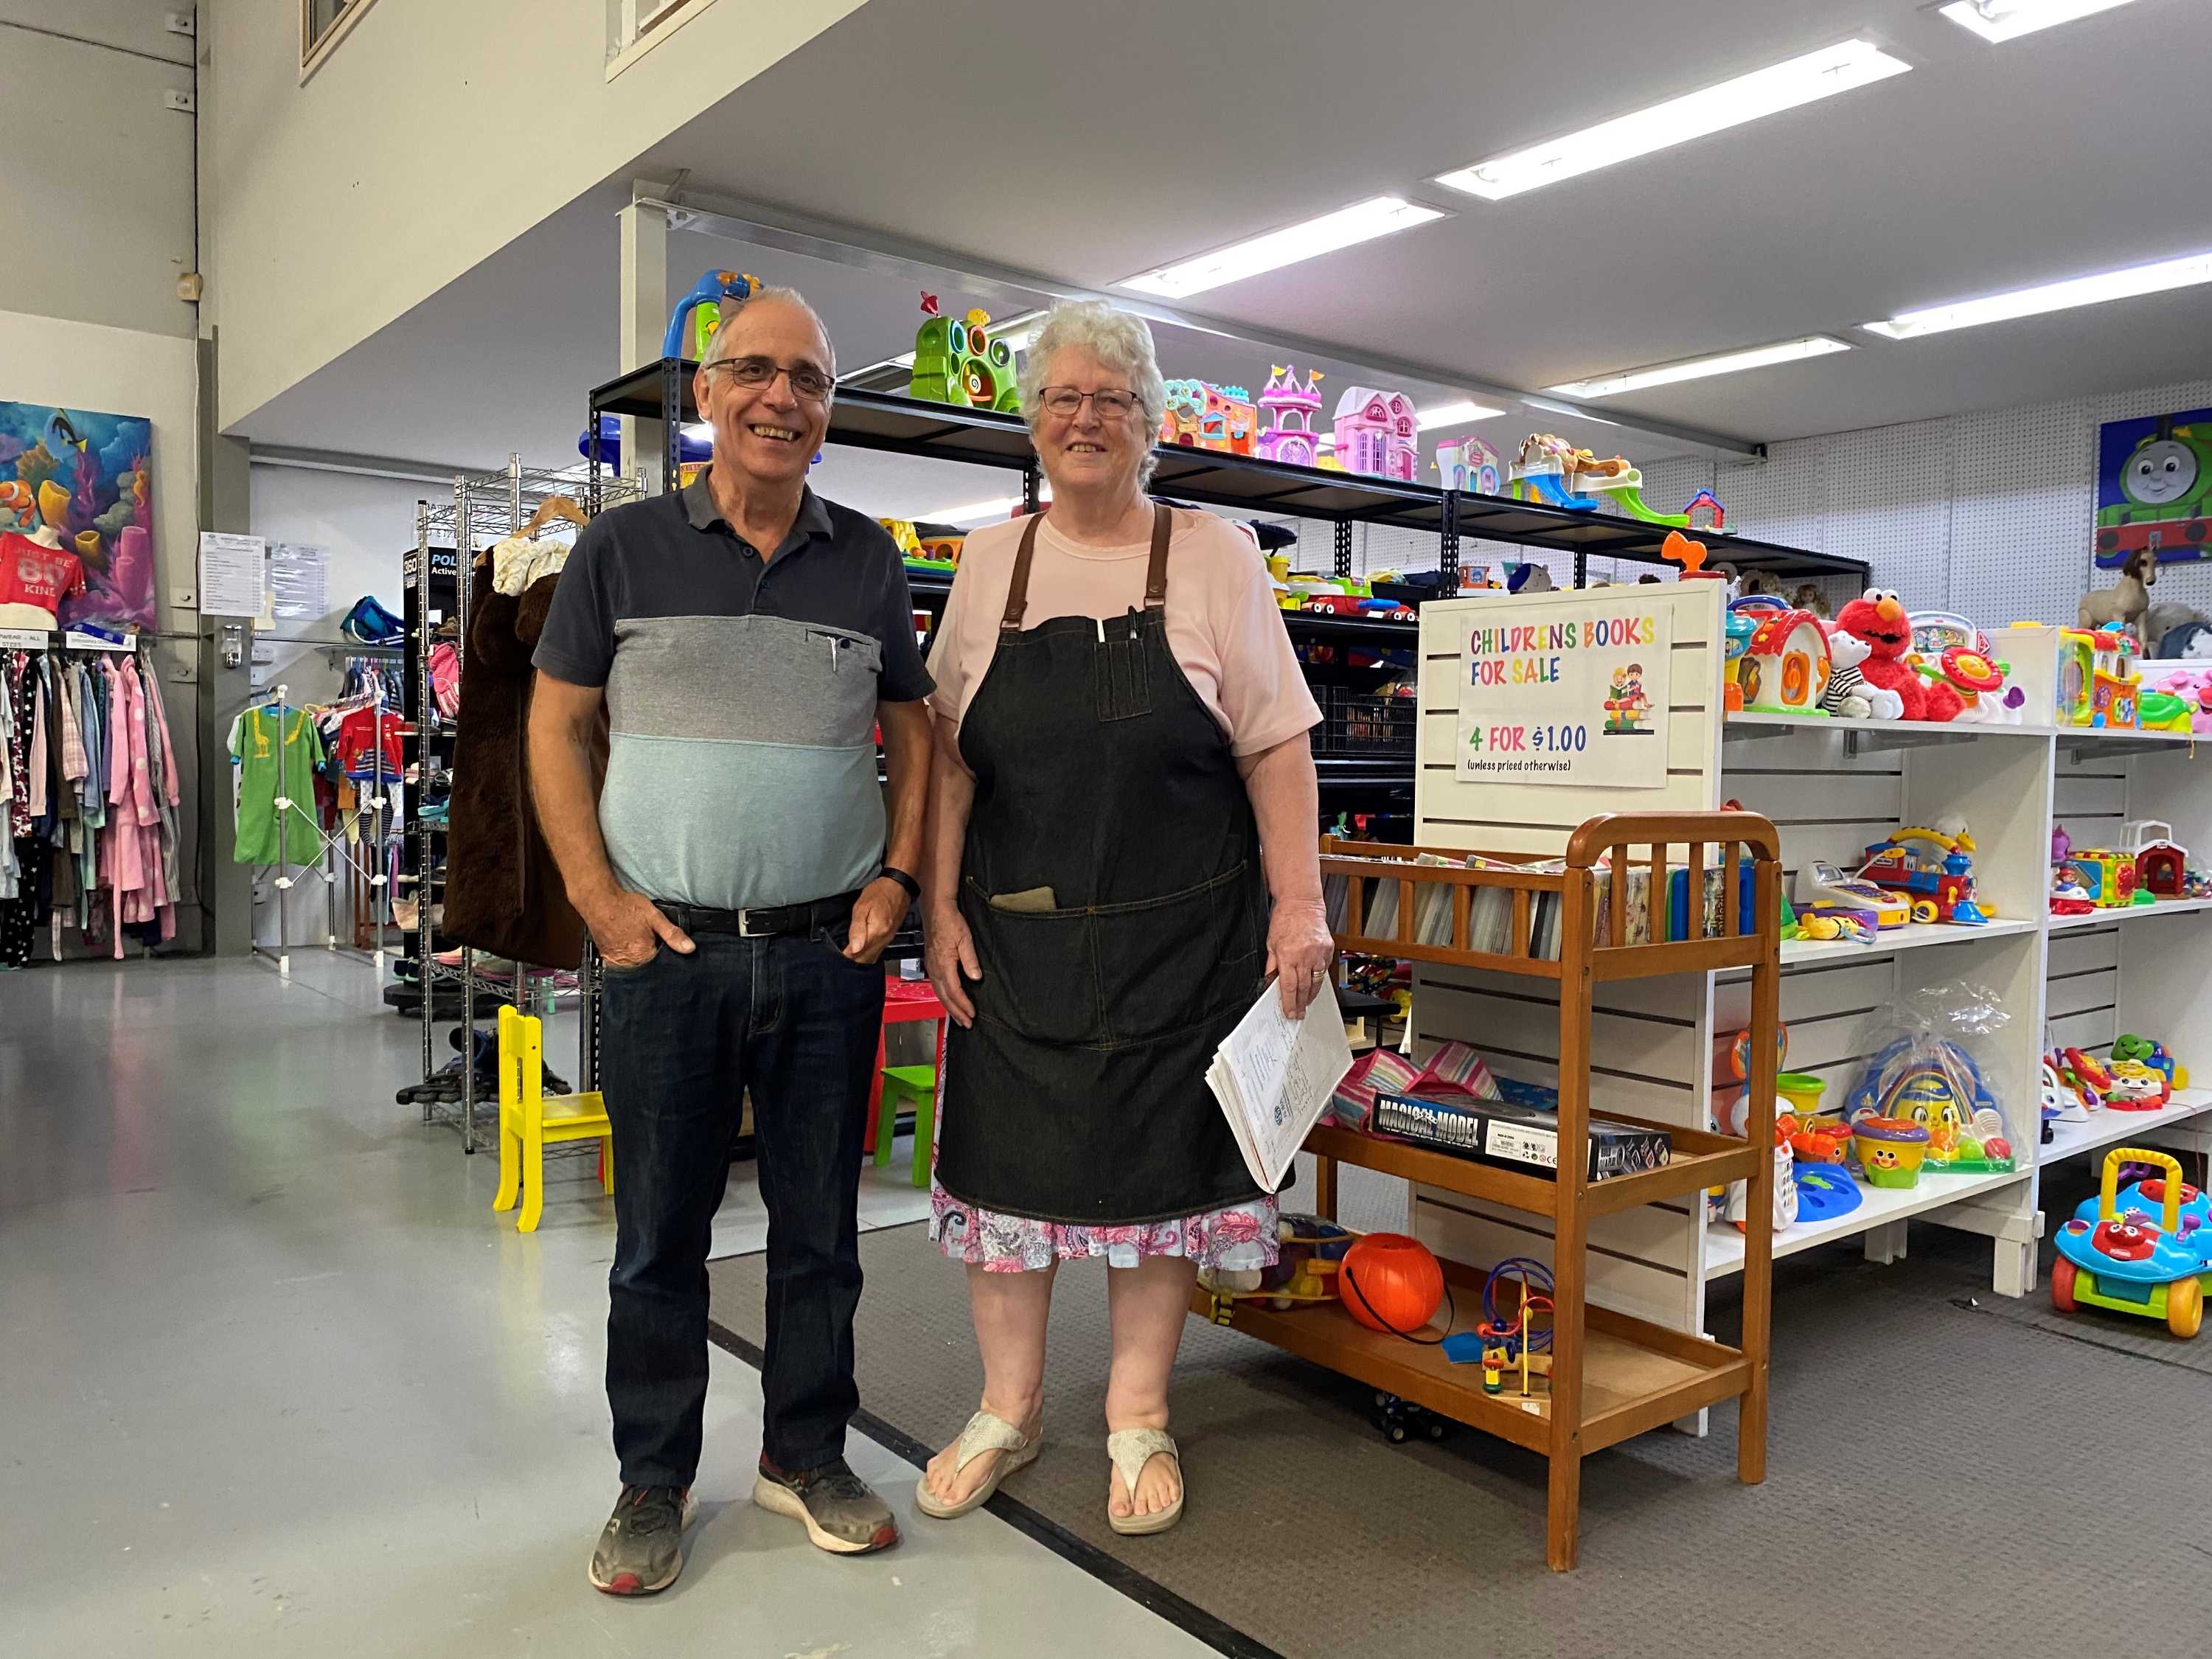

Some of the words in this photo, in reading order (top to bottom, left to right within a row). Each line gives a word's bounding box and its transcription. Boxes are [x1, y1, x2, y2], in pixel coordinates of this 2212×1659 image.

[55, 557, 72, 568] BE
[404, 557, 417, 575] 360
[1471, 622, 1576, 655] CHILDRENS
[1584, 616, 1655, 649] BOOKS
[1471, 660, 1506, 686] FOR
[1512, 656, 1560, 684] SALE
[1470, 726, 1483, 751] 4
[1489, 726, 1526, 751] FOR
[1532, 726, 1587, 751] $1.00
[1467, 759, 1495, 771] (unless
[1498, 759, 1522, 772] priced
[1524, 759, 1571, 771] otherwise)
[1379, 1100, 1433, 1136] MAGICAL
[1436, 1111, 1479, 1147] MODEL
